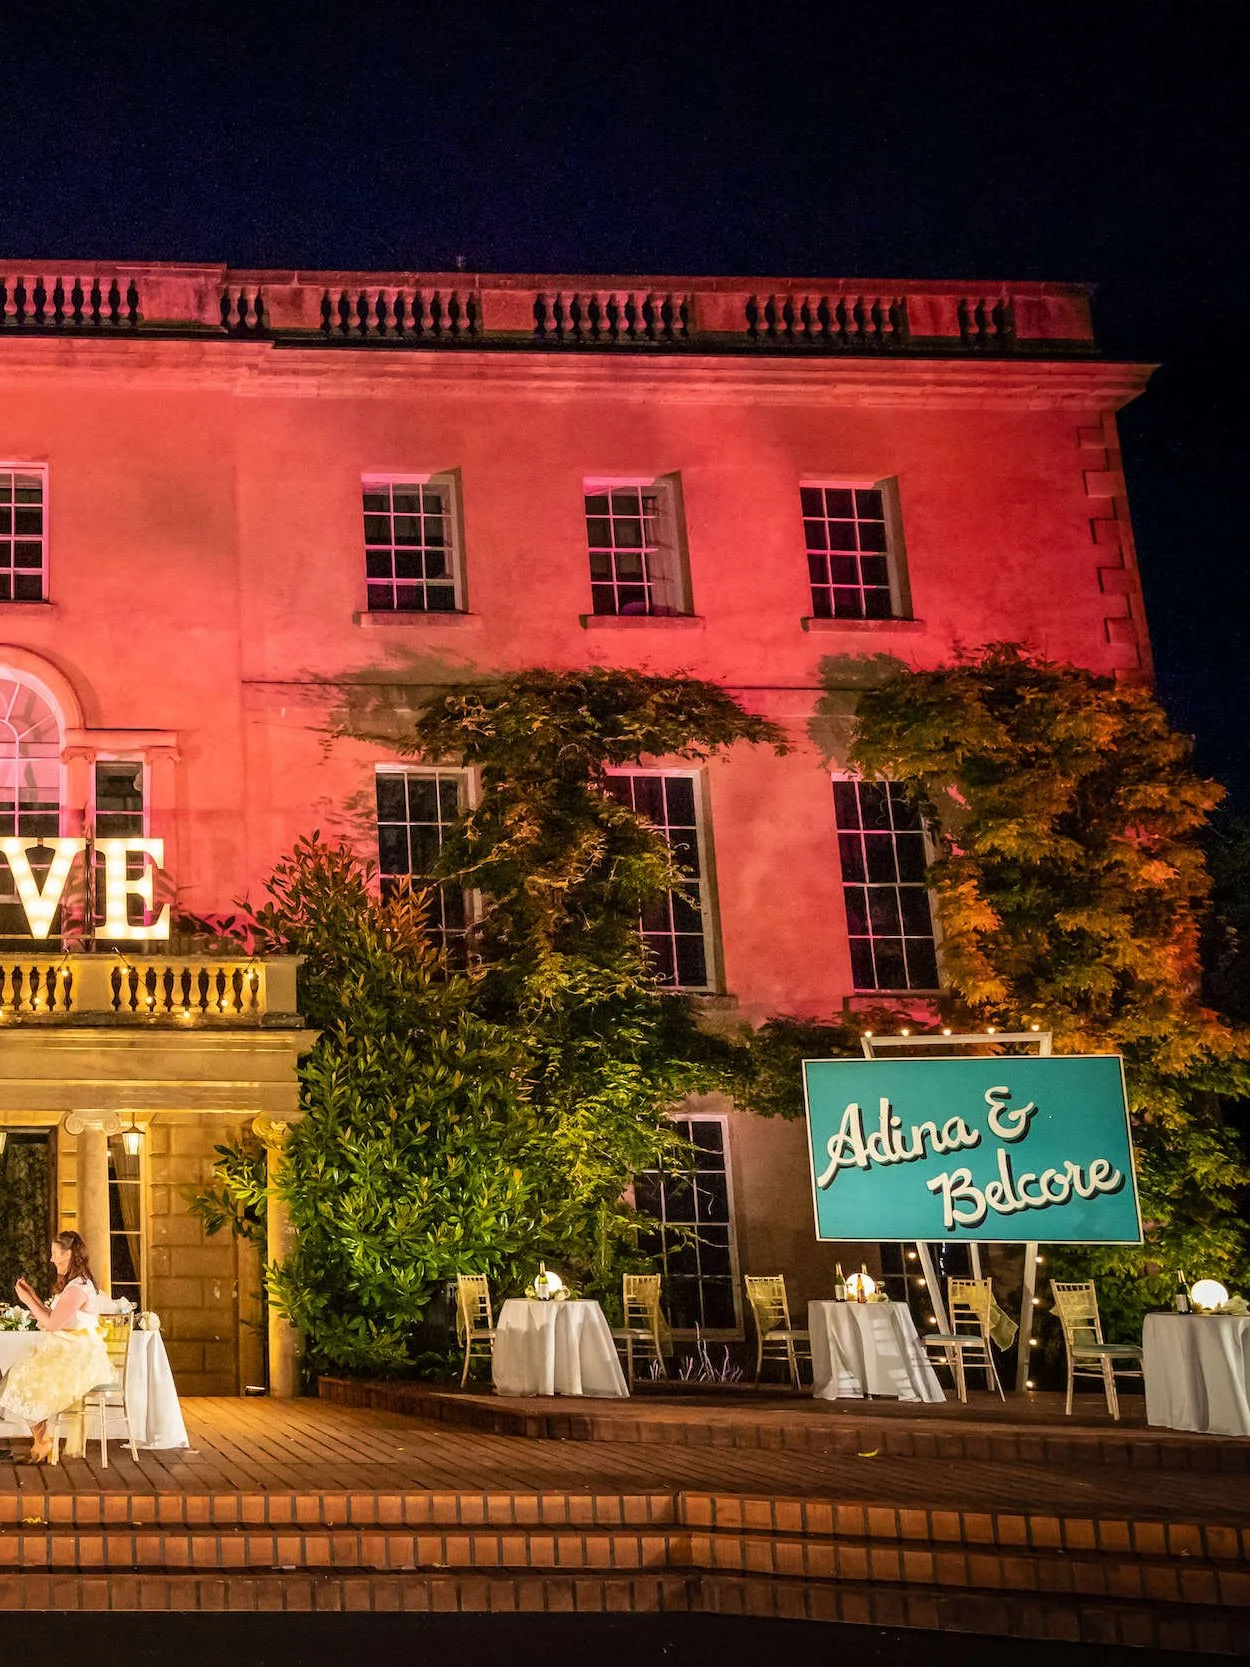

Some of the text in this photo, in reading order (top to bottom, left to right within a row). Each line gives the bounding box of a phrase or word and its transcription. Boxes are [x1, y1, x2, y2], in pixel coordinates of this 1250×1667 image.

[816, 1085, 1036, 1189] Adina &
[926, 1147, 1123, 1229] Belcore
